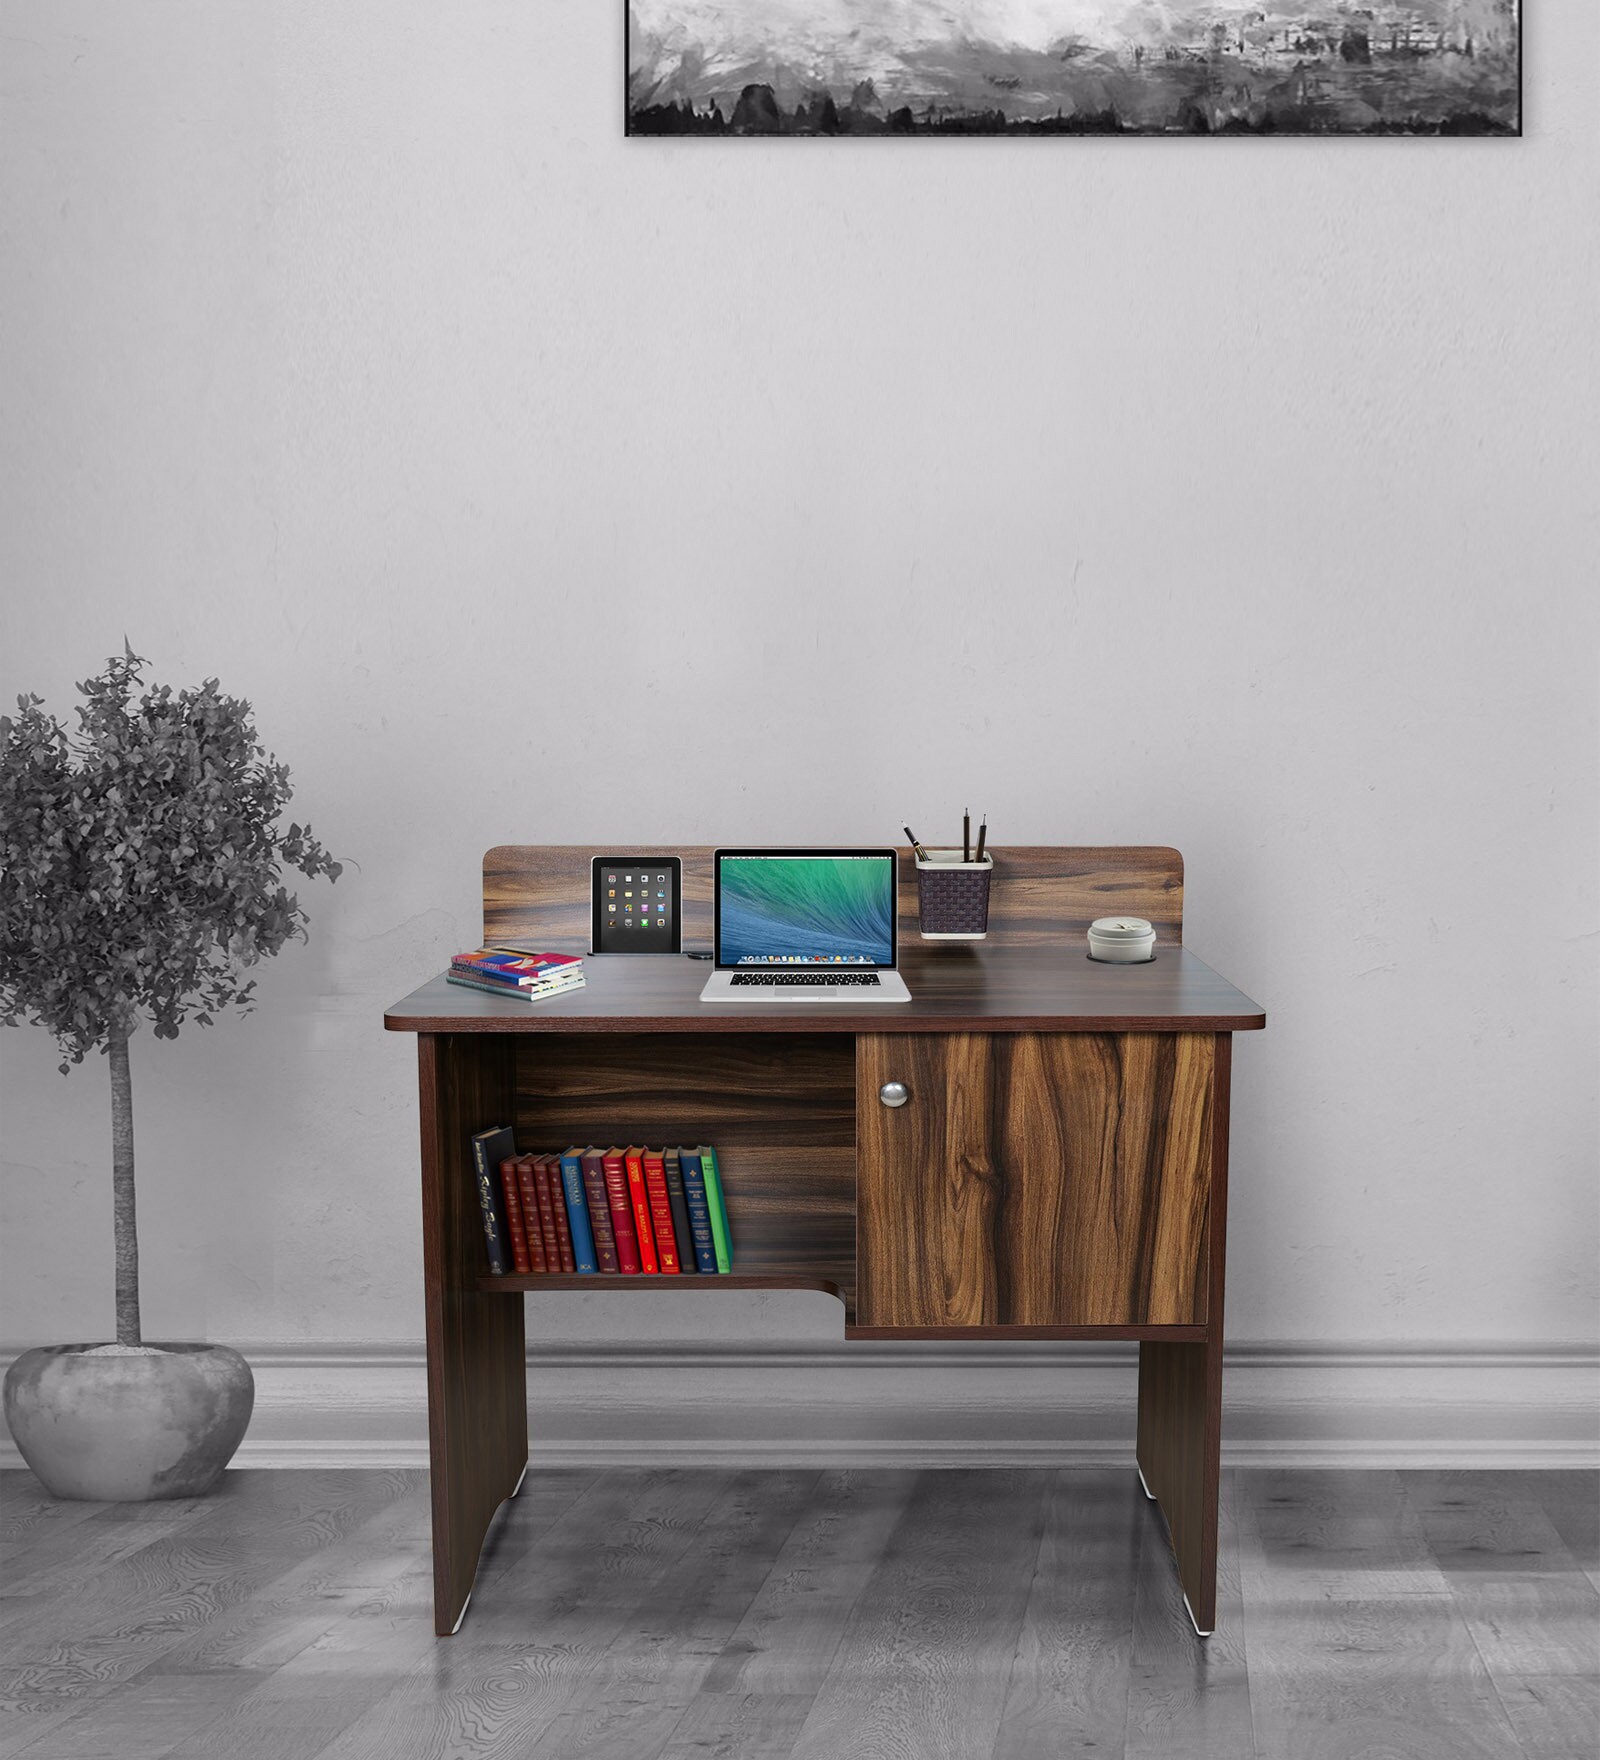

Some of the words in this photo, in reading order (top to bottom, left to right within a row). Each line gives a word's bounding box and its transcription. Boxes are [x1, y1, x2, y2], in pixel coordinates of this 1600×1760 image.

[479, 1175, 490, 1210] Ripley
[485, 1211, 497, 1242] Bogle
[605, 1163, 627, 1211] LUDLUM
